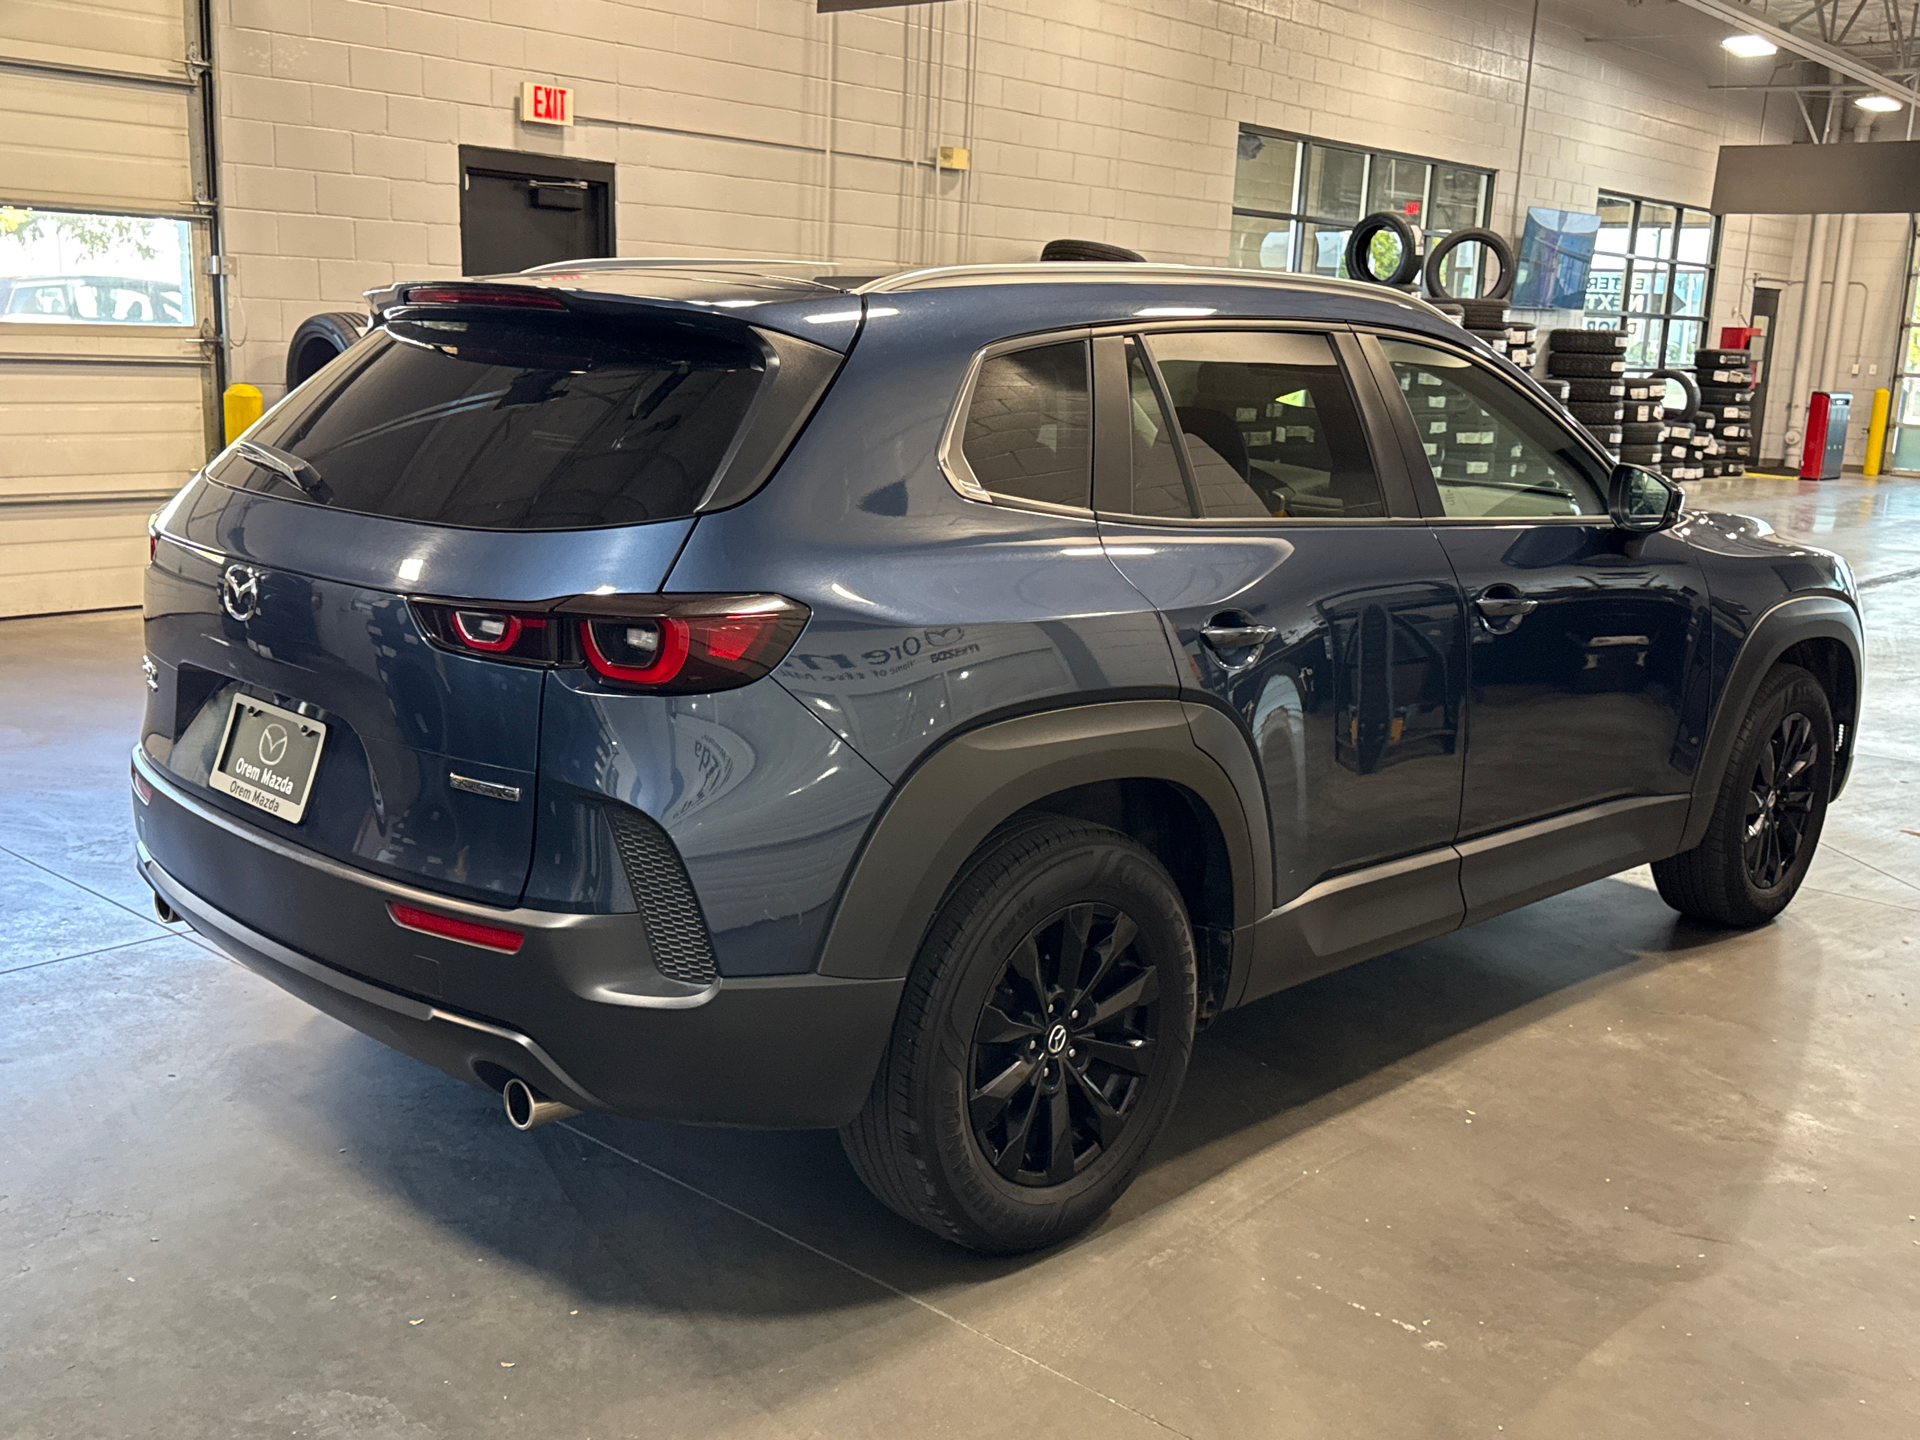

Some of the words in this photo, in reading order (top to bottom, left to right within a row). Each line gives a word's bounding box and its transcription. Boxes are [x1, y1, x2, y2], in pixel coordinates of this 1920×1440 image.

[533, 85, 567, 121] EXIT
[236, 758, 261, 781] Orem
[261, 768, 294, 795] Mazda
[229, 781, 252, 800] Orem
[252, 790, 280, 812] Mazda
